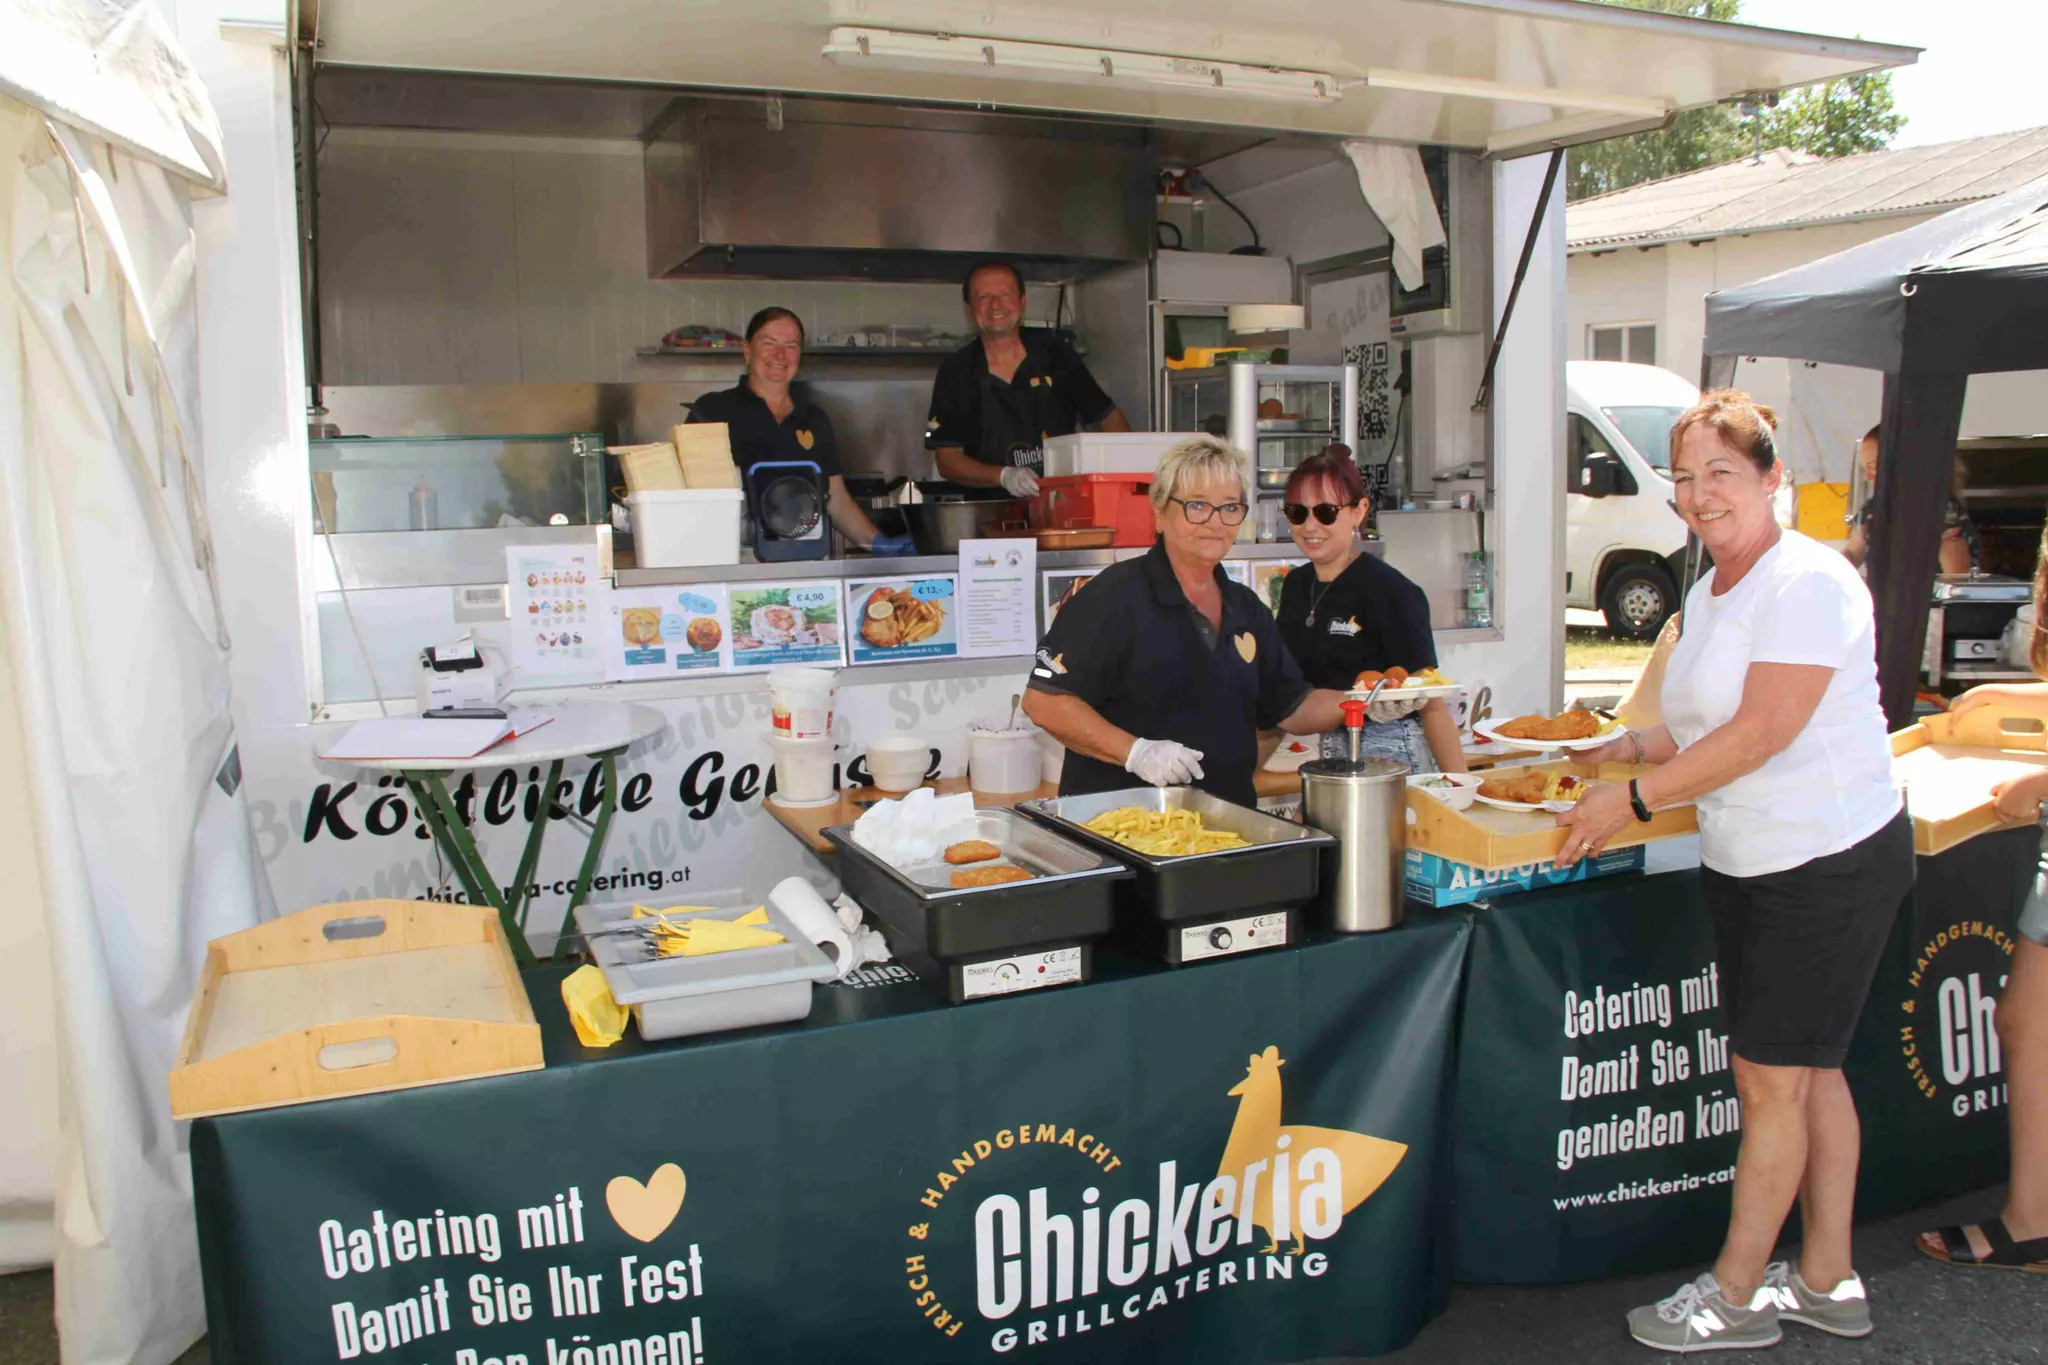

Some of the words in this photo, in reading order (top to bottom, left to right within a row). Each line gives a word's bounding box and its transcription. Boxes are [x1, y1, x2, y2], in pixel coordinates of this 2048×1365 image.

[803, 592, 824, 602] 4,90
[918, 587, 924, 595] €
[1908, 921, 2017, 987] HANDGEMACH
[1564, 981, 1673, 1039] Catering
[1680, 962, 1719, 1014] mit
[1902, 999, 1916, 1013] &
[1560, 1044, 1640, 1101] Damit
[1651, 1039, 1690, 1086] Sie
[1697, 1028, 1729, 1075] Ihr
[1901, 1026, 1937, 1099] FRISCH
[920, 1123, 1121, 1209] HANDGEMACHT
[1556, 1105, 1685, 1170] genießen
[1695, 1089, 1742, 1139] kön
[1553, 1165, 1737, 1211] www.chickeria-cat
[318, 1208, 501, 1280] Catering
[518, 1186, 584, 1249] mit
[908, 1223, 929, 1240] &
[975, 1134, 1343, 1320] Chickeria
[331, 1278, 451, 1359] Damit
[468, 1273, 533, 1326] Sie
[548, 1265, 603, 1317] Ihr
[620, 1243, 703, 1307] Fest
[906, 1254, 964, 1337] FRISCH
[991, 1252, 1328, 1352] GRILLCATERING
